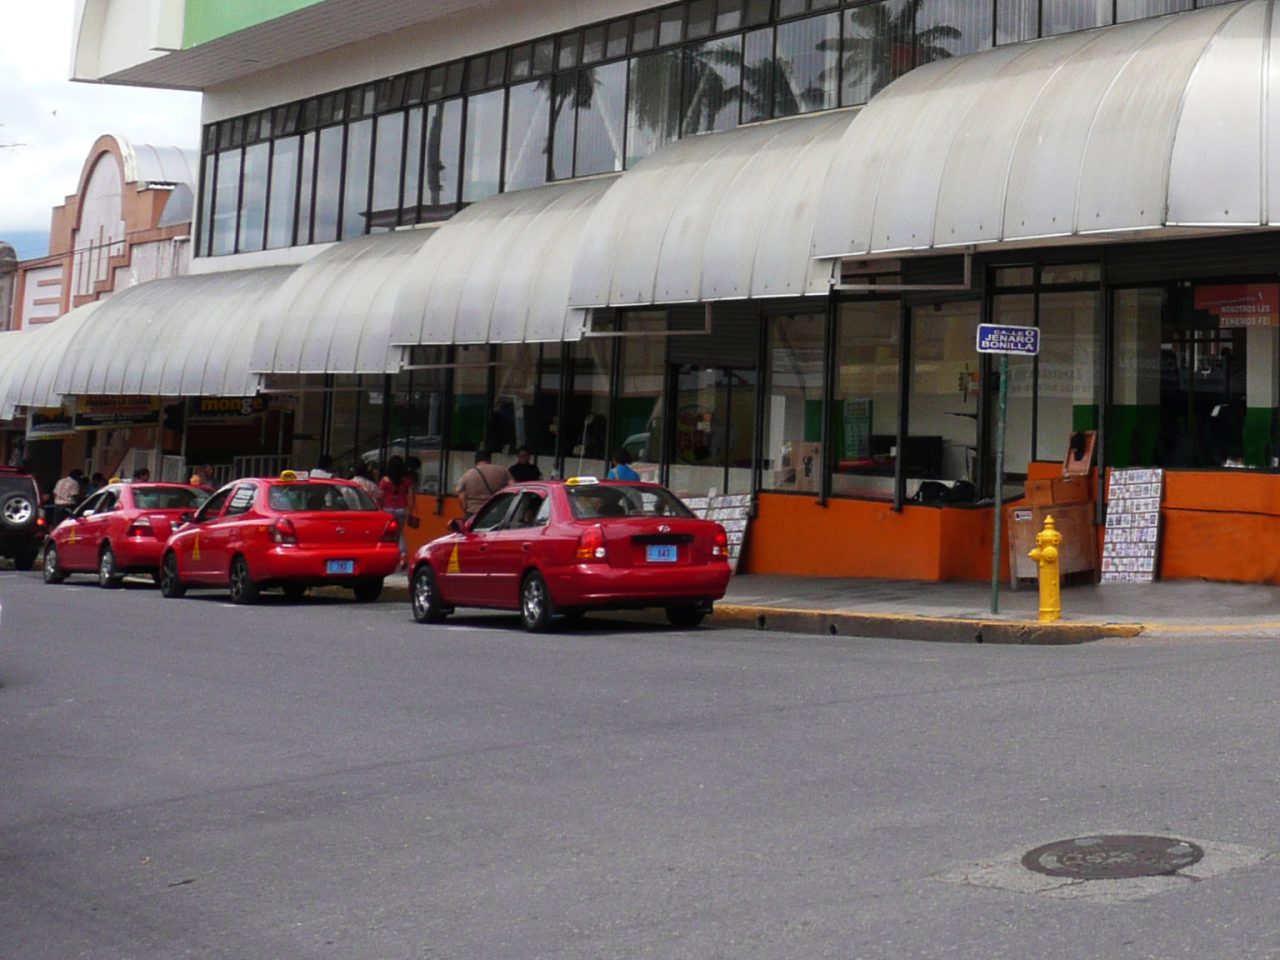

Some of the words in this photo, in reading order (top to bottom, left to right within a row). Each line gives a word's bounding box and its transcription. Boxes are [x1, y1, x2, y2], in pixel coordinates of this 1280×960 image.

[1221, 305, 1256, 313] NOSOTROS
[1257, 304, 1271, 312] LES
[1221, 317, 1256, 326] TENEMOS
[985, 334, 1034, 344] JENARO
[981, 340, 1034, 350] BONILLA
[201, 399, 262, 414] monge
